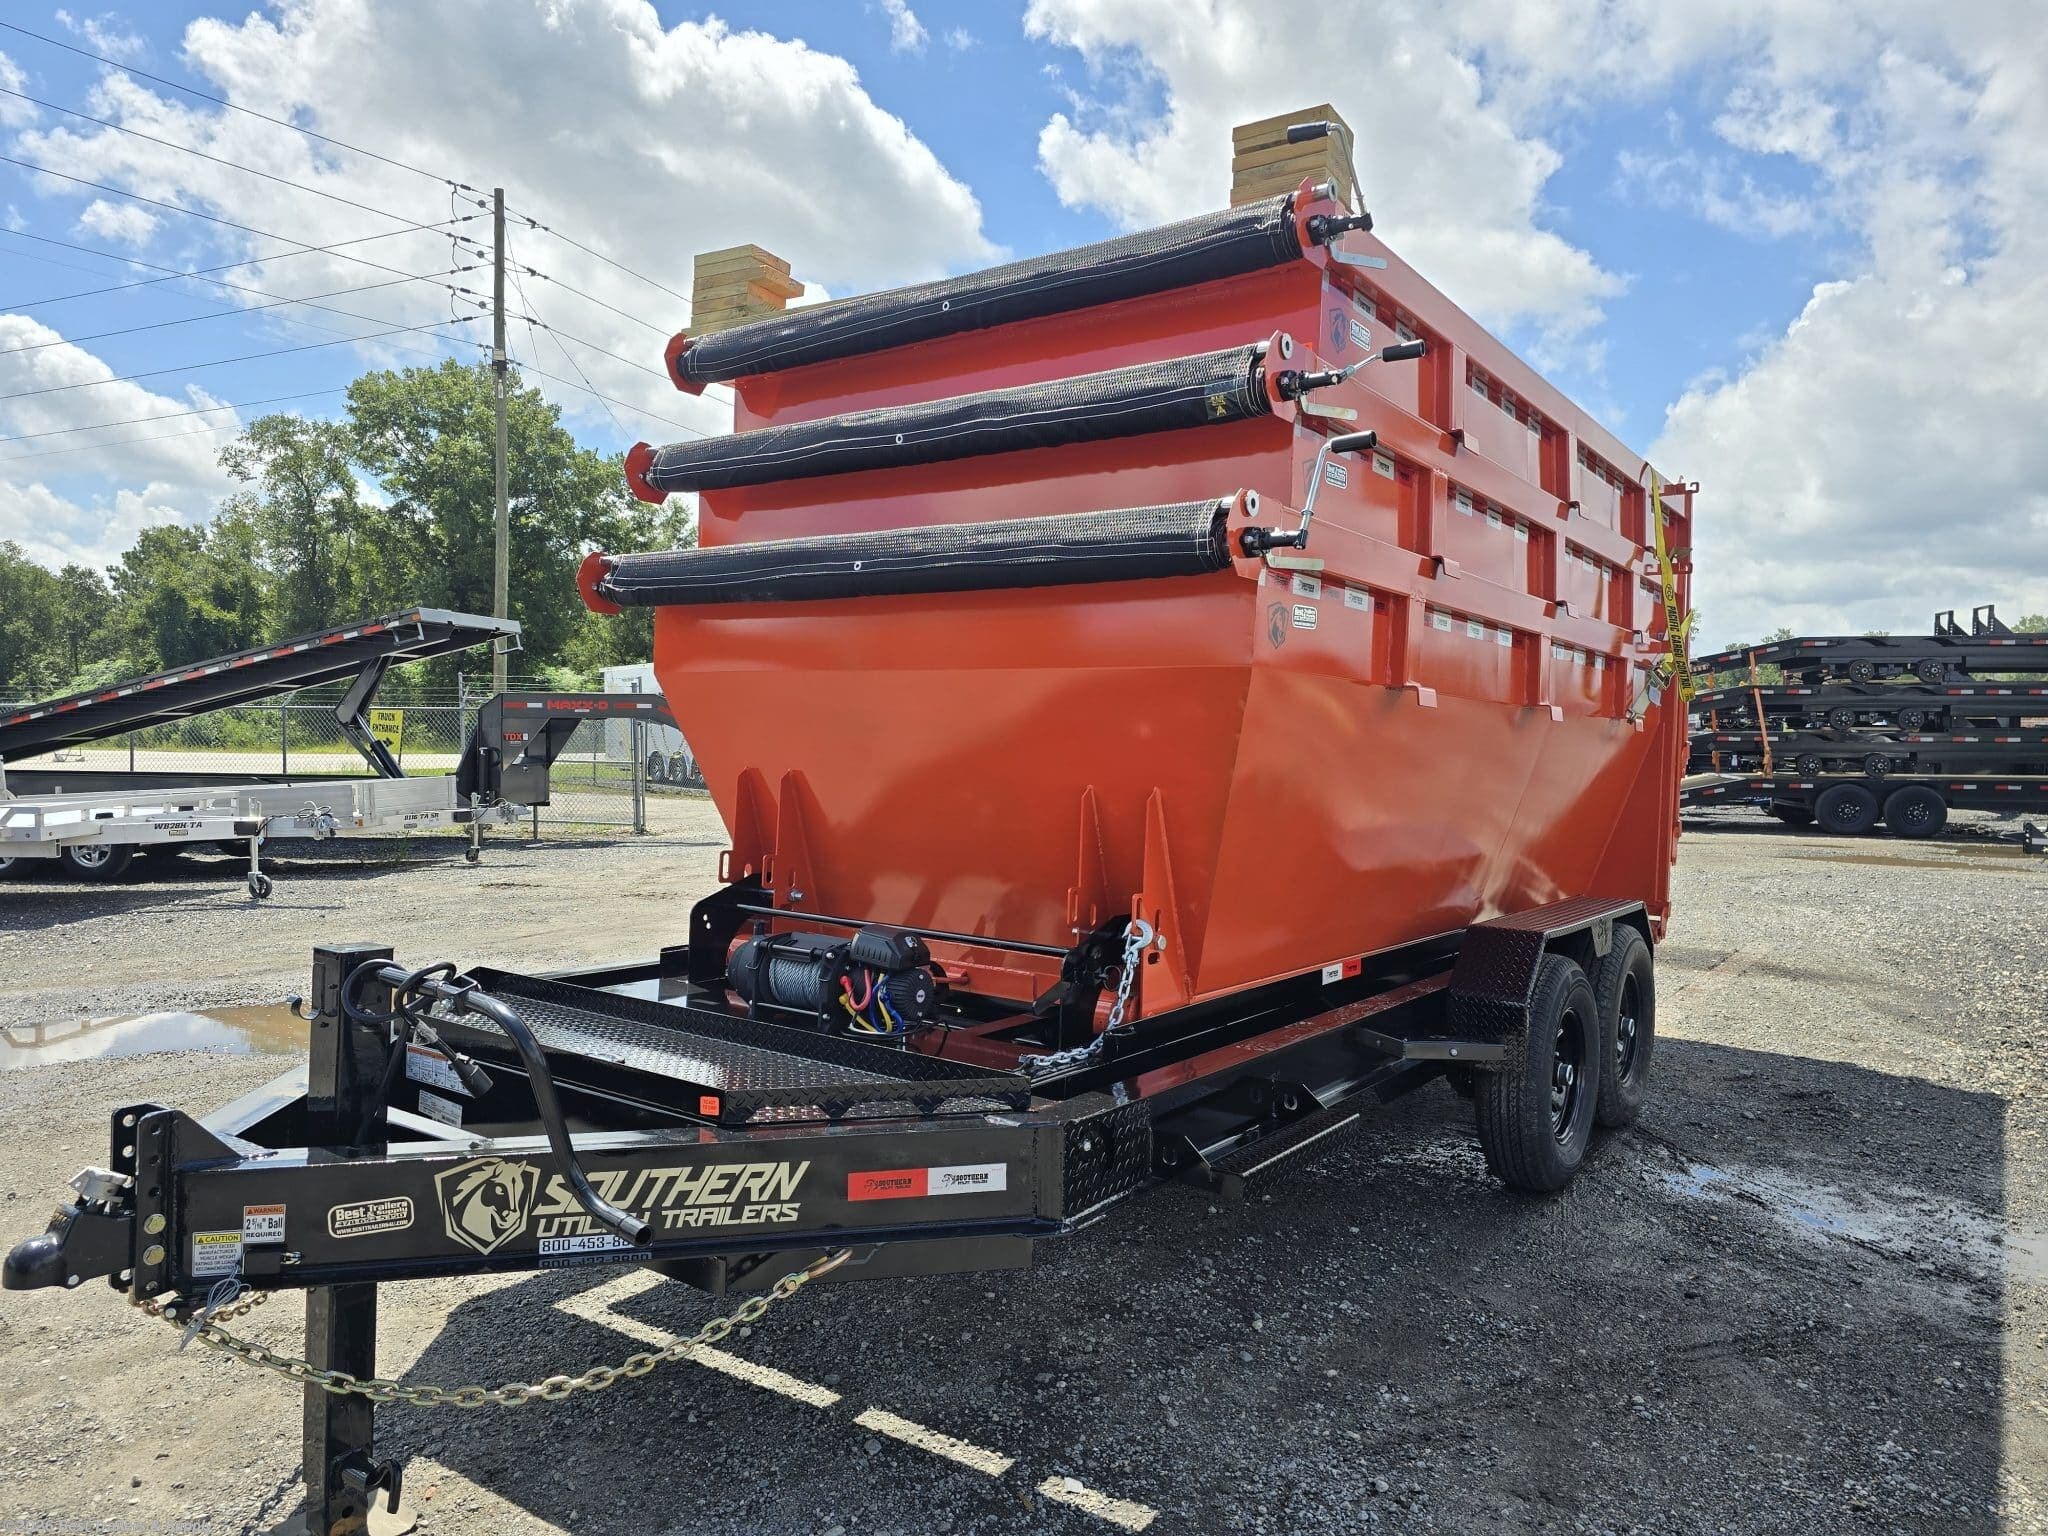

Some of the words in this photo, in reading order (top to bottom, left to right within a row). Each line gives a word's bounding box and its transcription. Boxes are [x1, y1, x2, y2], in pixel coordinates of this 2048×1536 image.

[1666, 604, 1680, 632] PACIFIC
[1670, 633, 1684, 658] CARGO
[547, 700, 609, 710] MAXX-D
[377, 712, 396, 721] TRUCK
[372, 723, 400, 733] ENTRANCE
[504, 732, 523, 741] TDX
[532, 1160, 811, 1216] SOUTHERN
[335, 1206, 366, 1221] Best
[368, 1201, 408, 1212] Trailers
[662, 1202, 801, 1229] TRAILERS
[246, 1218, 251, 1230] 2
[268, 1217, 283, 1229] Ball
[205, 1234, 239, 1243] CAUTION
